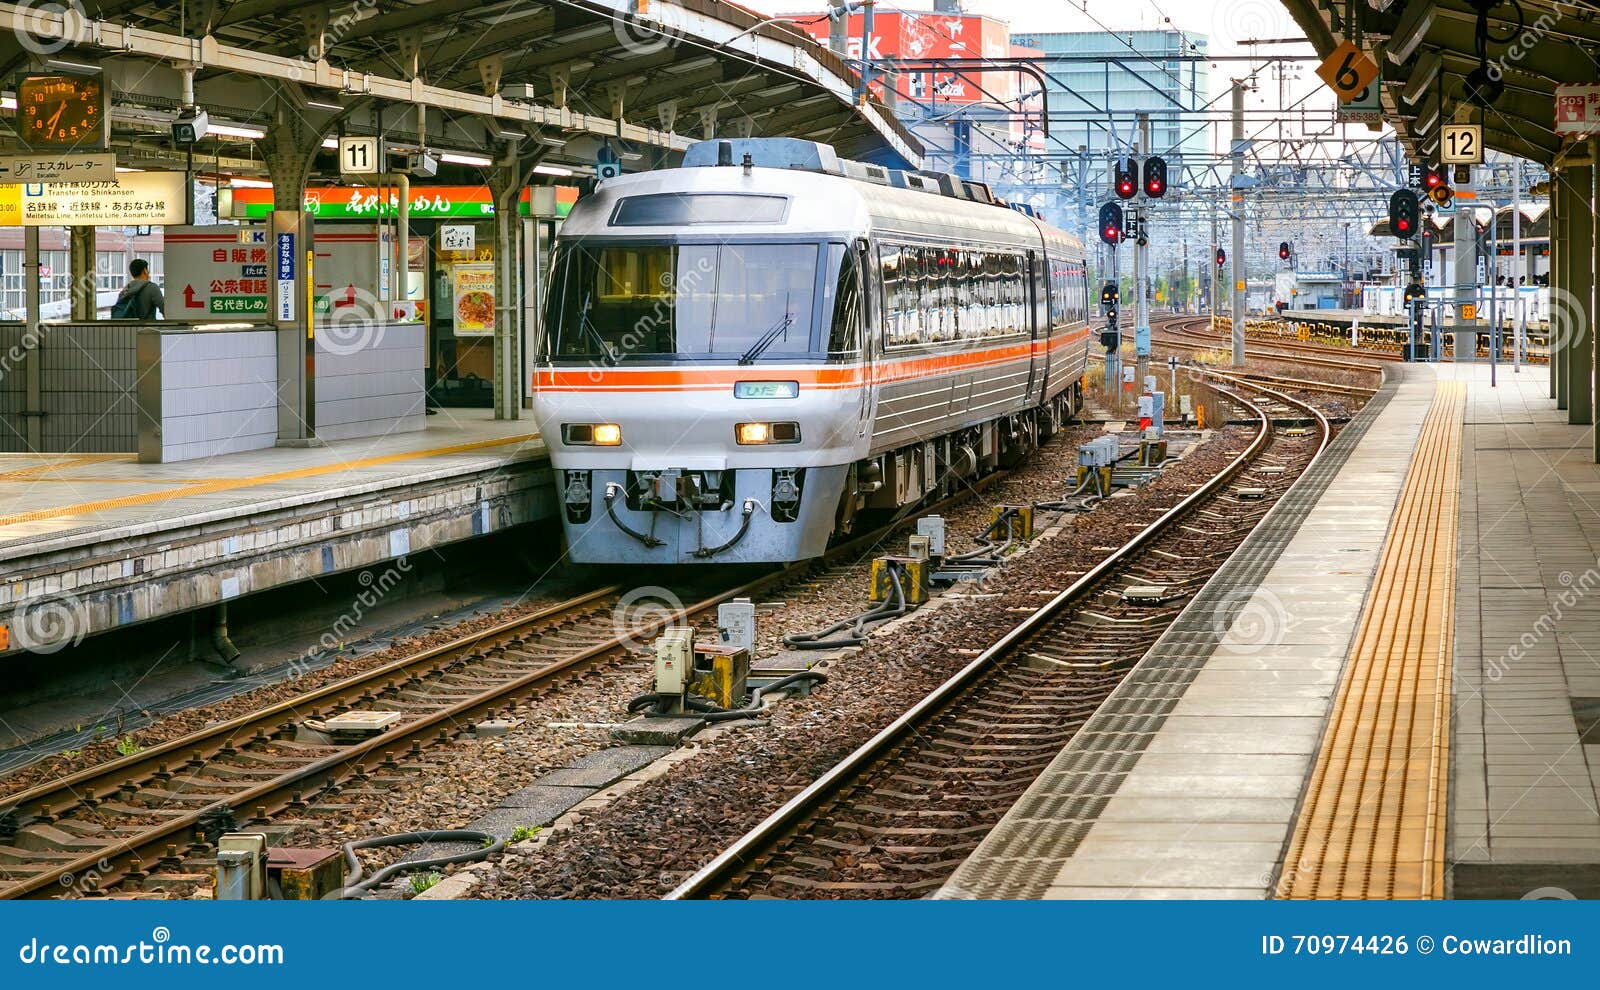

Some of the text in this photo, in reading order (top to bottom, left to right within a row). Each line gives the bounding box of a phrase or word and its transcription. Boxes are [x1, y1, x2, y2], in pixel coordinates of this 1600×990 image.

[1335, 51, 1359, 91] 6
[44, 85, 54, 94] 11
[56, 82, 66, 91] 12
[35, 93, 44, 102] 10
[80, 91, 87, 101] 2
[1560, 96, 1583, 105] SOS
[29, 106, 36, 115] 9
[87, 105, 94, 115] 3
[36, 119, 43, 129] 8
[81, 119, 87, 128] 4
[59, 128, 66, 138] 6
[70, 126, 77, 136] 5
[1446, 131, 1474, 156] 12
[347, 144, 367, 167] 11
[36, 161, 103, 171] エスカレーター
[1409, 165, 1421, 187] 上本
[213, 248, 267, 263] 自販機
[210, 279, 267, 294] 公衆電話
